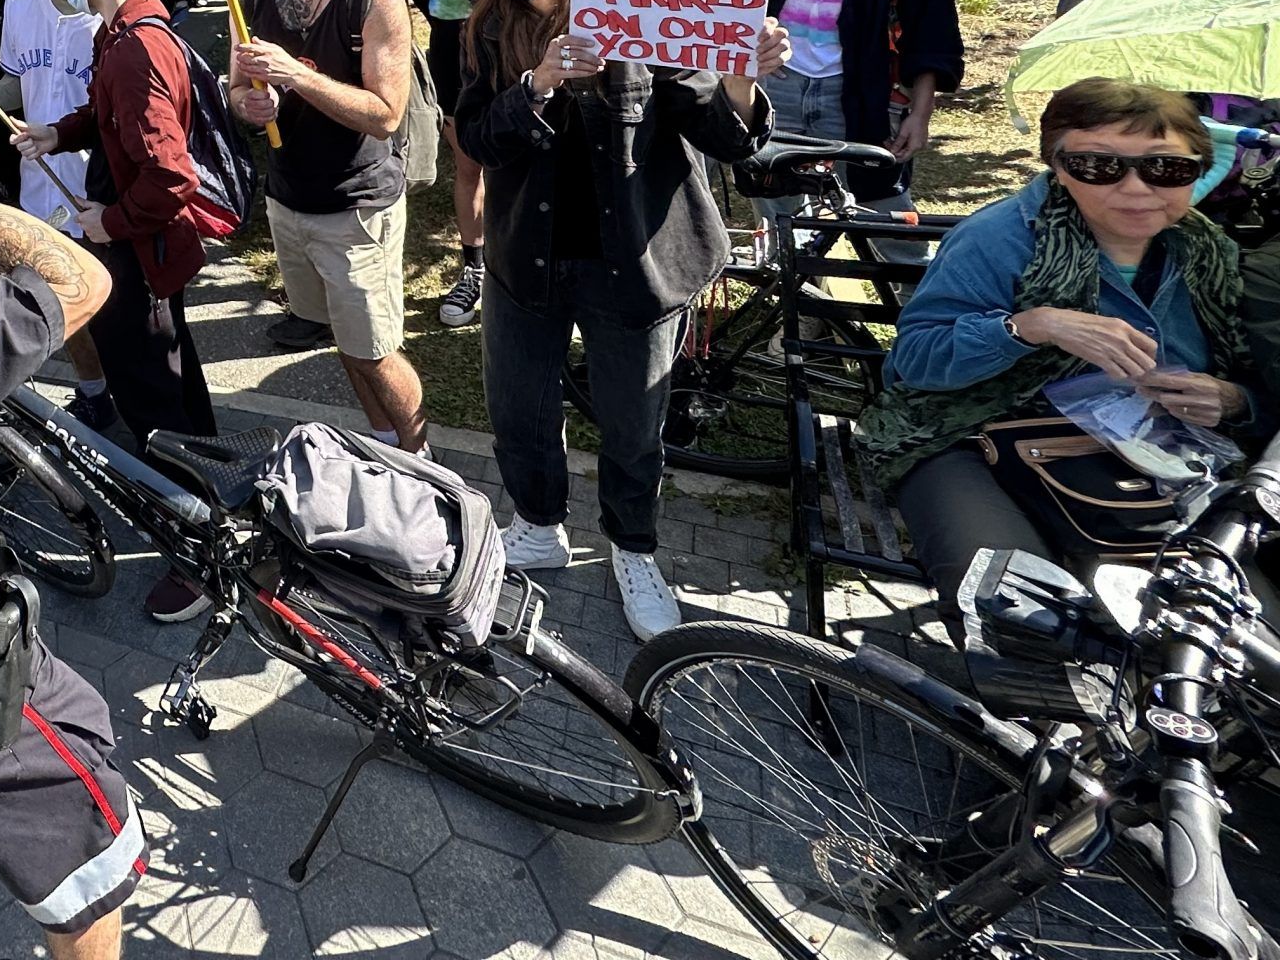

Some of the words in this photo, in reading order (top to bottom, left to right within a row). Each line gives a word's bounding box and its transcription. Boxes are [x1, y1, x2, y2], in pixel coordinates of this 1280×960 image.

[574, 8, 643, 38] ON
[658, 16, 756, 49] OUR
[18, 48, 52, 76] BLUE
[65, 58, 92, 85] JA
[592, 33, 752, 76] YOUTH
